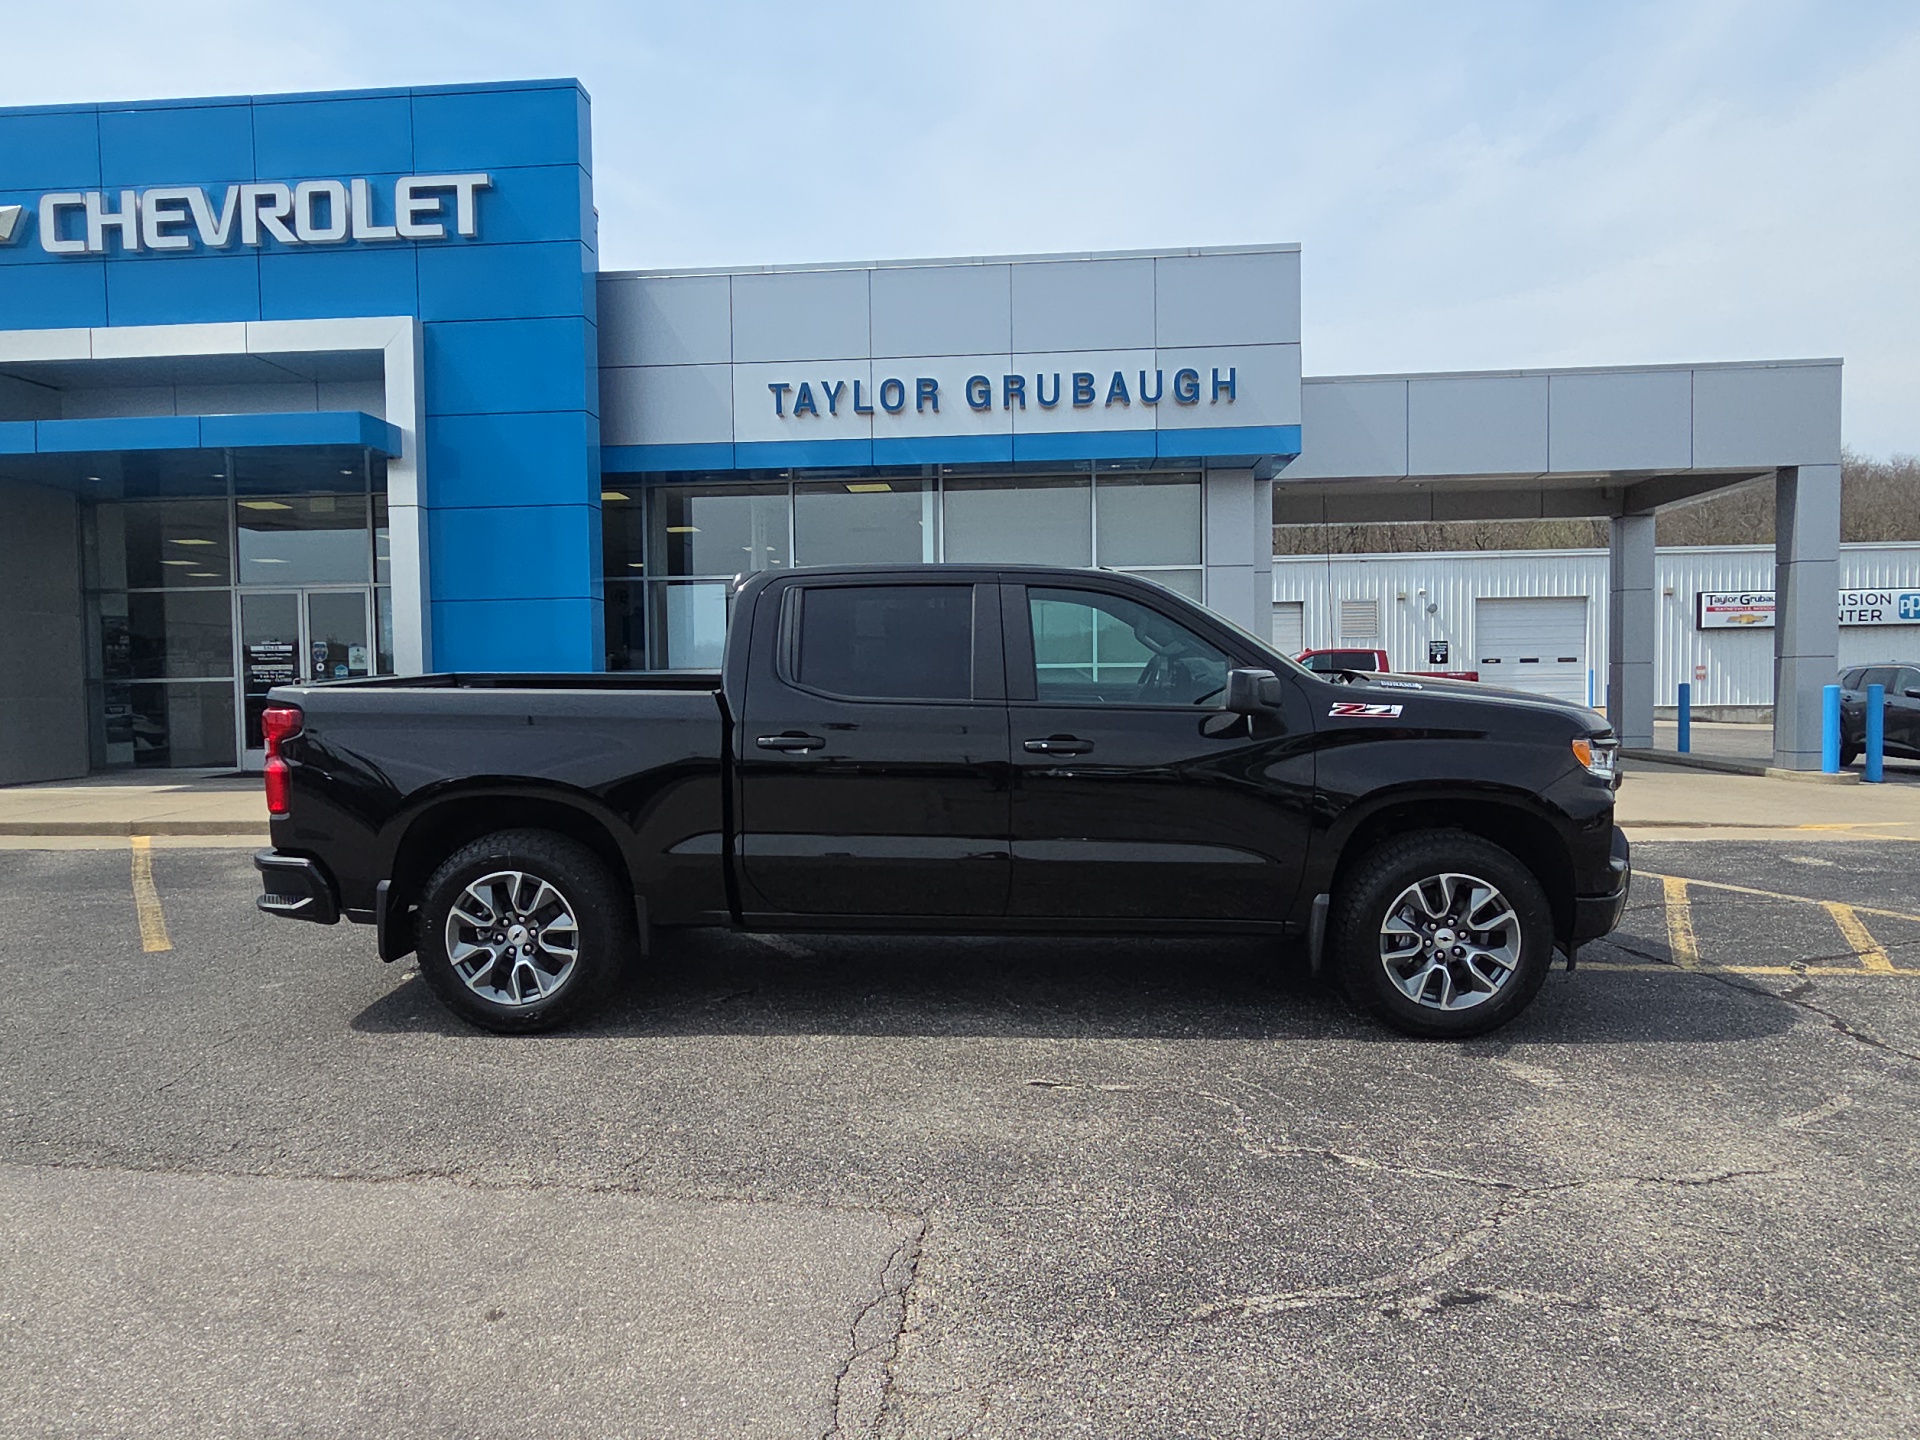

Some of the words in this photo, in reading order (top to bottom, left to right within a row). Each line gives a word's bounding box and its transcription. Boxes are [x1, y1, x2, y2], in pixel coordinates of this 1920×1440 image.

[38, 172, 491, 253] CHEVROLET
[767, 376, 940, 416] TAYLOR
[964, 367, 1238, 411] GRUBAUGH
[1706, 594, 1738, 606] Taylor
[1838, 593, 1892, 606] ISION
[1328, 702, 1404, 718] Z71
